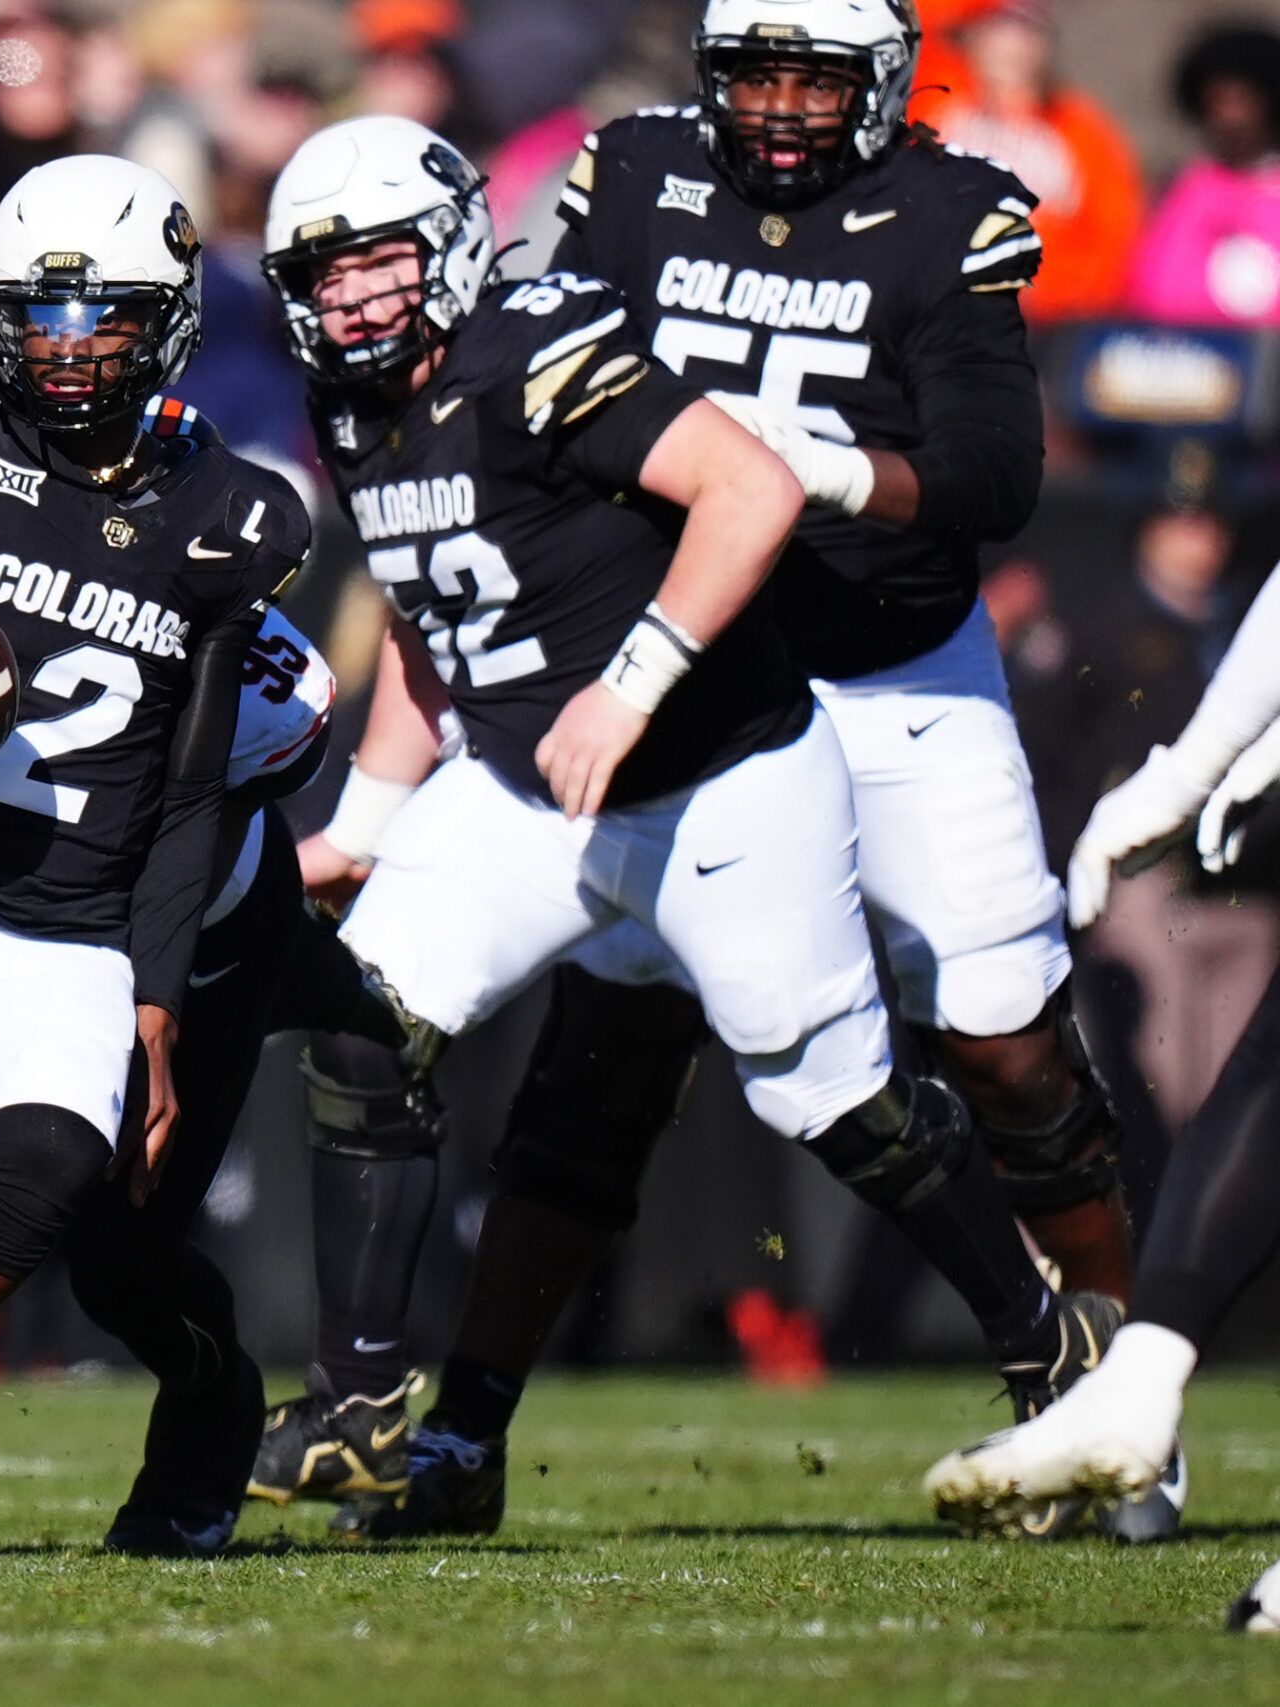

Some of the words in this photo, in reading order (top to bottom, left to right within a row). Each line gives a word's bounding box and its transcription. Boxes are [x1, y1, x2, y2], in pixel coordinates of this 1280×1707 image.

[45, 254, 81, 268] BUFFS
[656, 256, 872, 333] COLORADO
[239, 500, 266, 543] L
